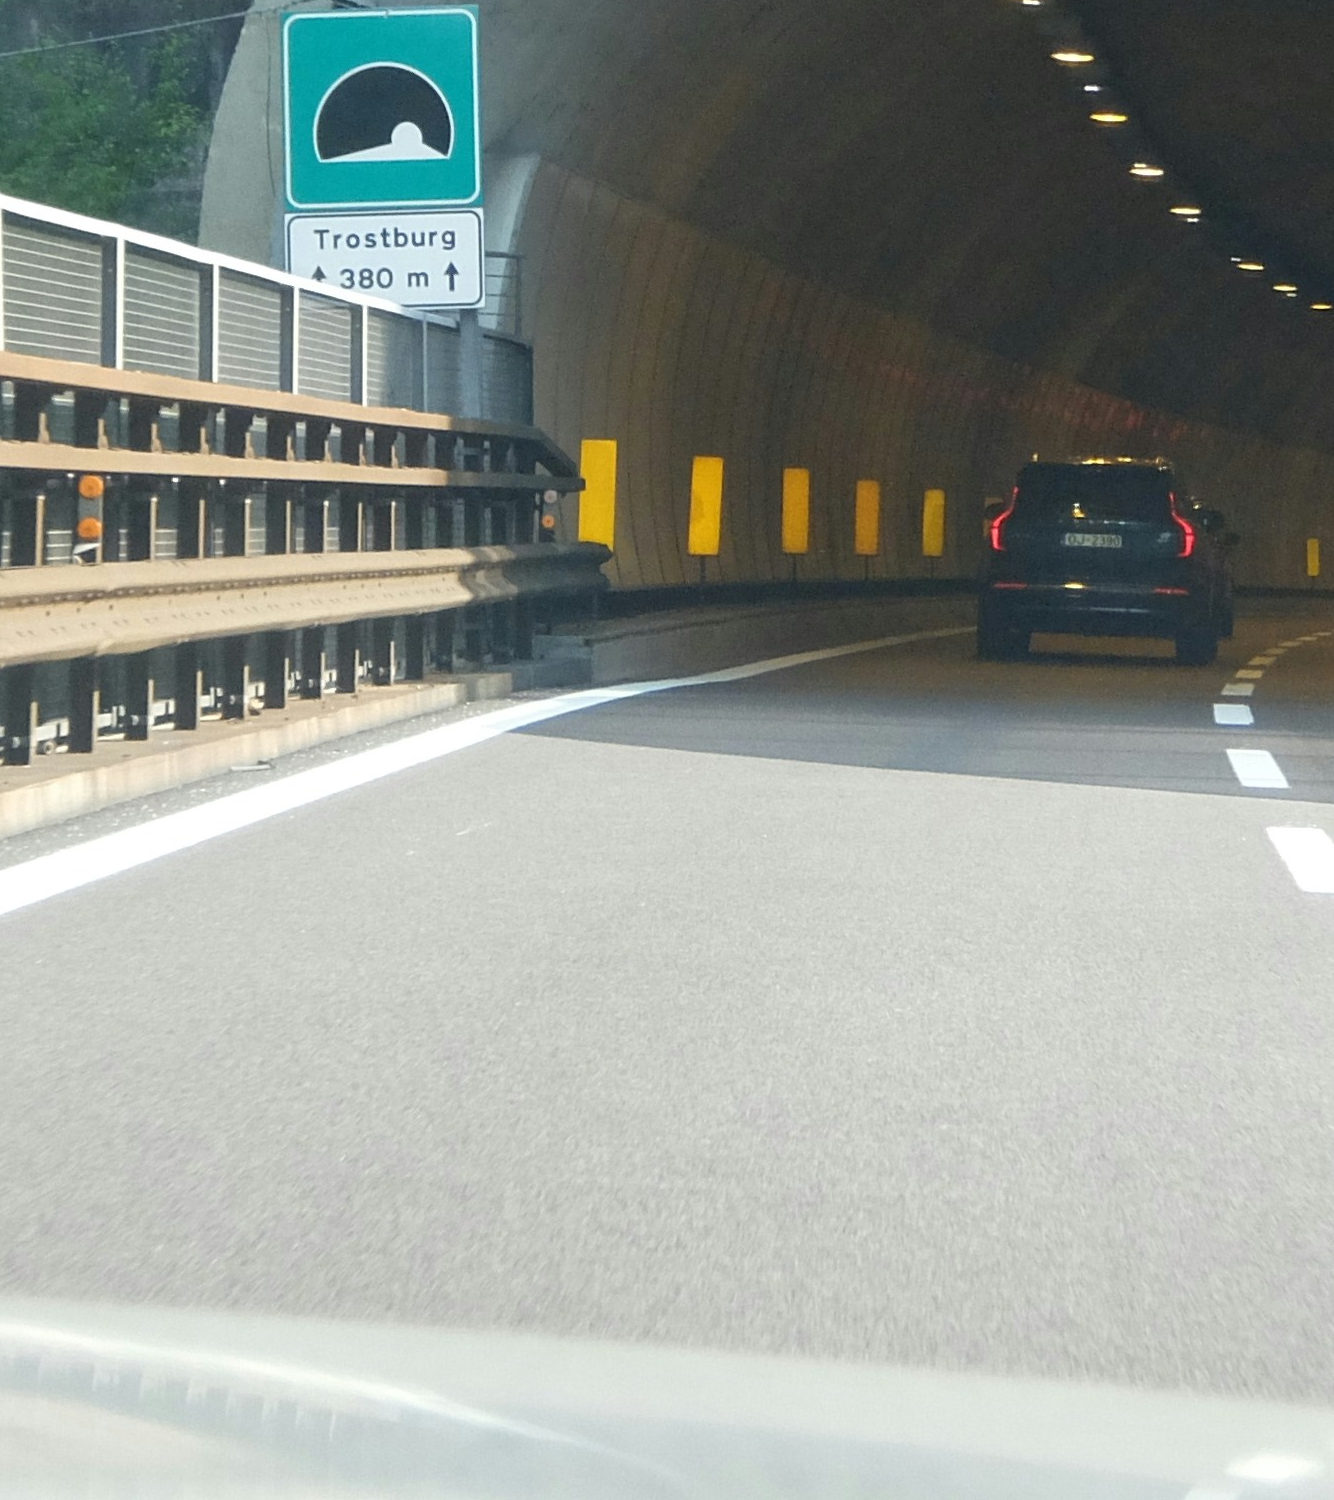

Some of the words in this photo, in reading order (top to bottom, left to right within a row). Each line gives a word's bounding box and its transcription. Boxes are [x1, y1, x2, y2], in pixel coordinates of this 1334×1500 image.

[314, 227, 456, 251] Trostburg
[339, 267, 394, 289] 380
[407, 271, 430, 287] m
